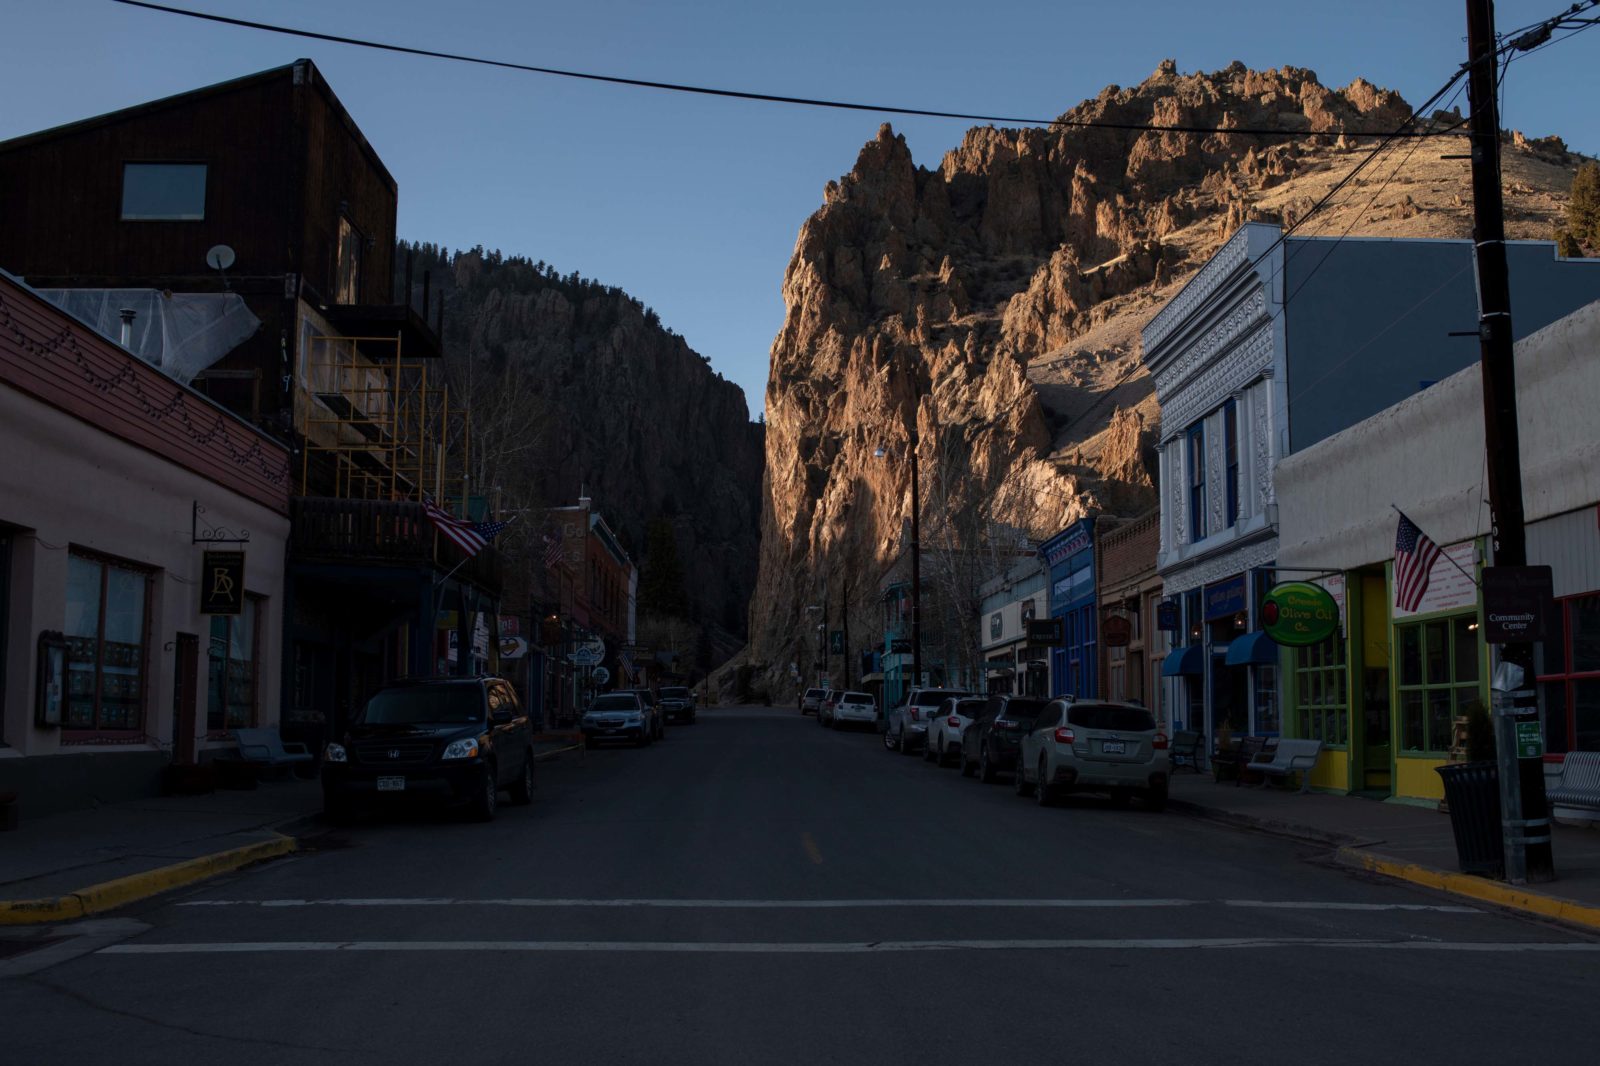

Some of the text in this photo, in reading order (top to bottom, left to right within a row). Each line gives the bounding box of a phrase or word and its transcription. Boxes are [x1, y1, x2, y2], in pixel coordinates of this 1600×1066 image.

[1280, 607, 1333, 621] Olive Oil
[1489, 611, 1535, 623] Community
[1502, 622, 1528, 631] Center
